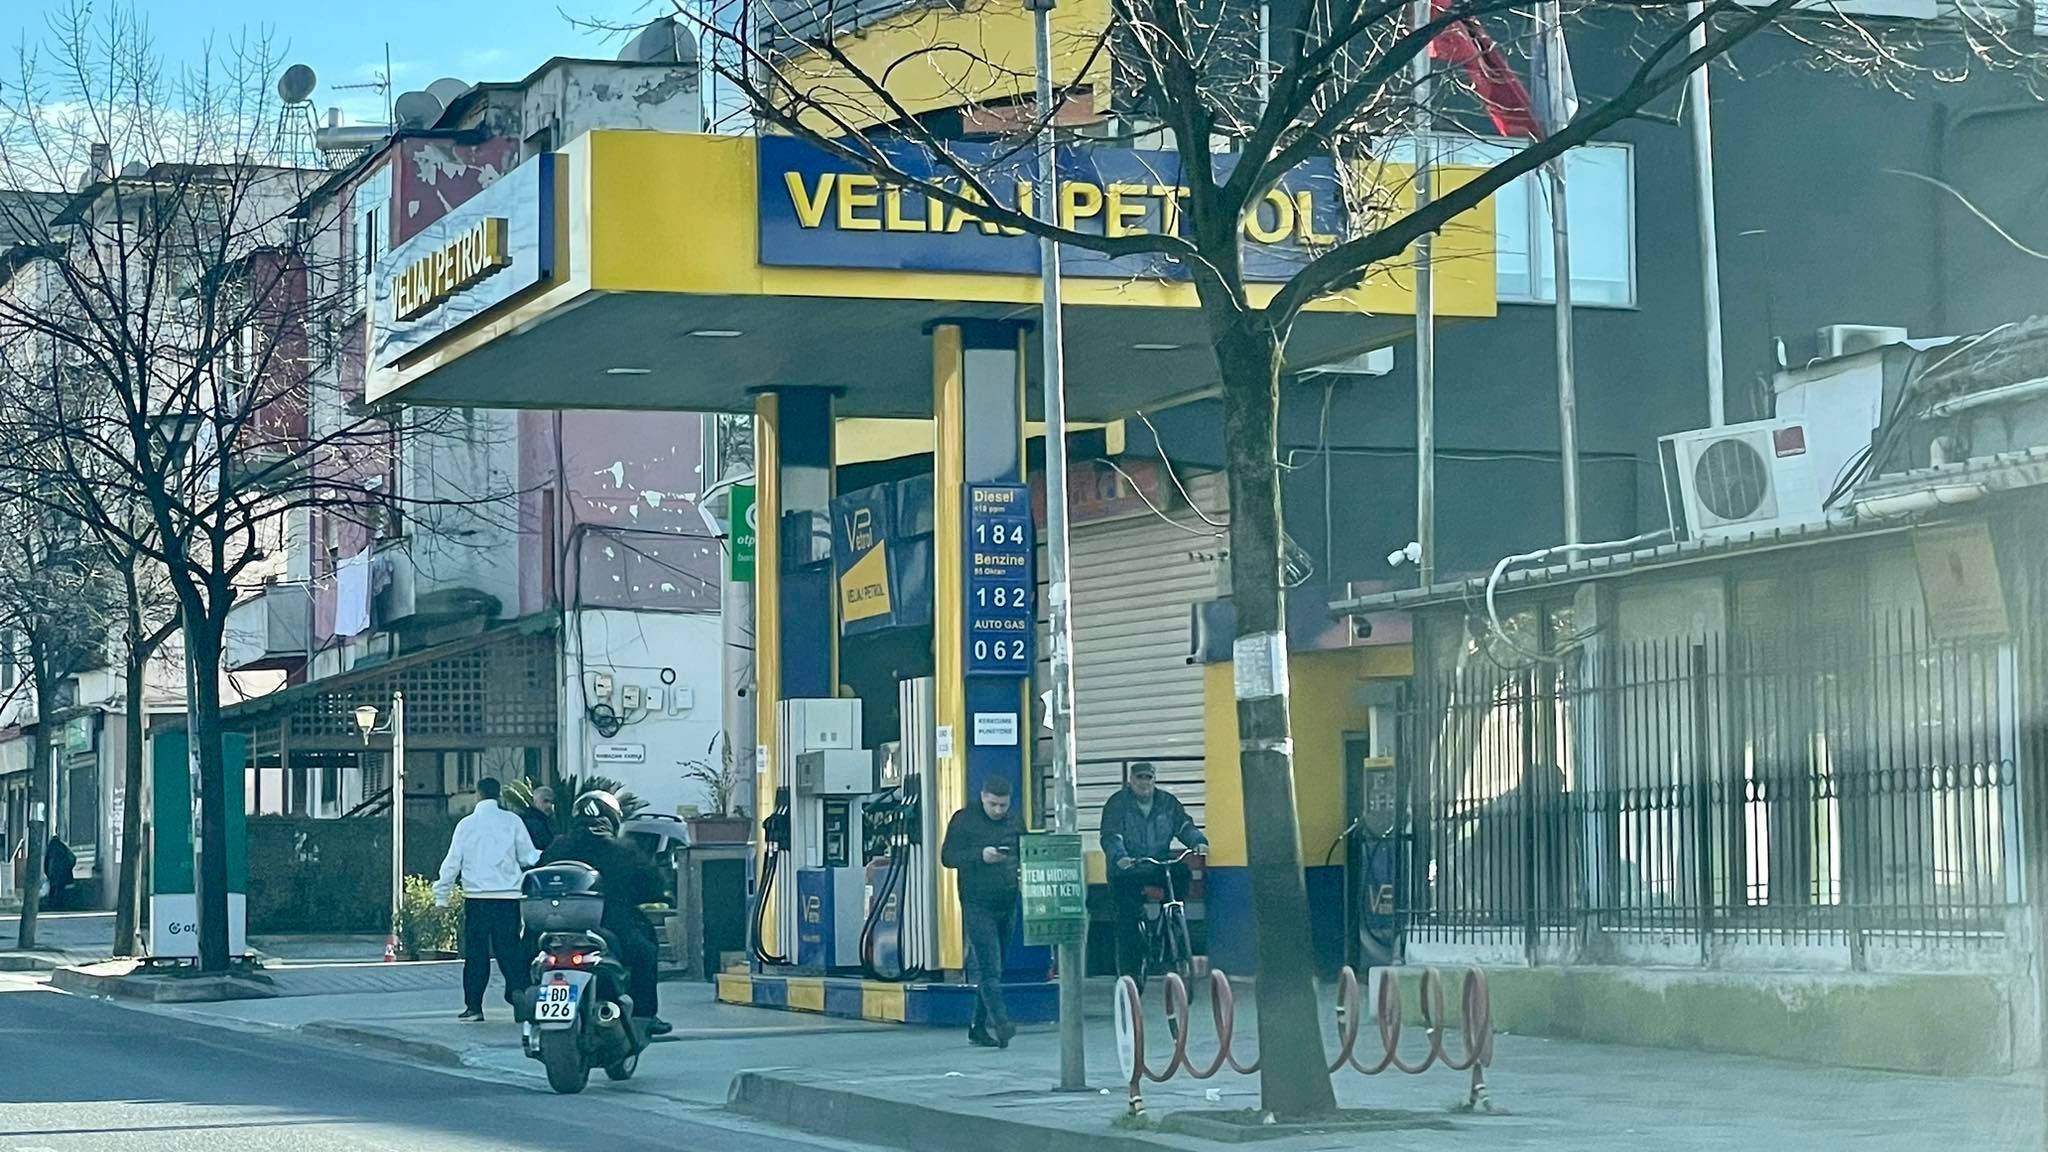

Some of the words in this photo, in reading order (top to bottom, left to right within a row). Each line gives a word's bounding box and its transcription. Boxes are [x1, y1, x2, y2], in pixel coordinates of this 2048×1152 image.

[784, 171, 1034, 236] VELIAJ
[1060, 180, 1337, 246] PETOL
[436, 217, 498, 296] PETROL
[974, 490, 1014, 503] Diesel
[976, 524, 1024, 545] 184
[974, 553, 1025, 566] Benzine
[976, 587, 1025, 608] 182
[974, 619, 1002, 630] AUTO
[1004, 619, 1025, 630] GAS
[974, 640, 1025, 661] 062
[551, 988, 568, 1002] BD
[541, 1003, 570, 1018] 926
